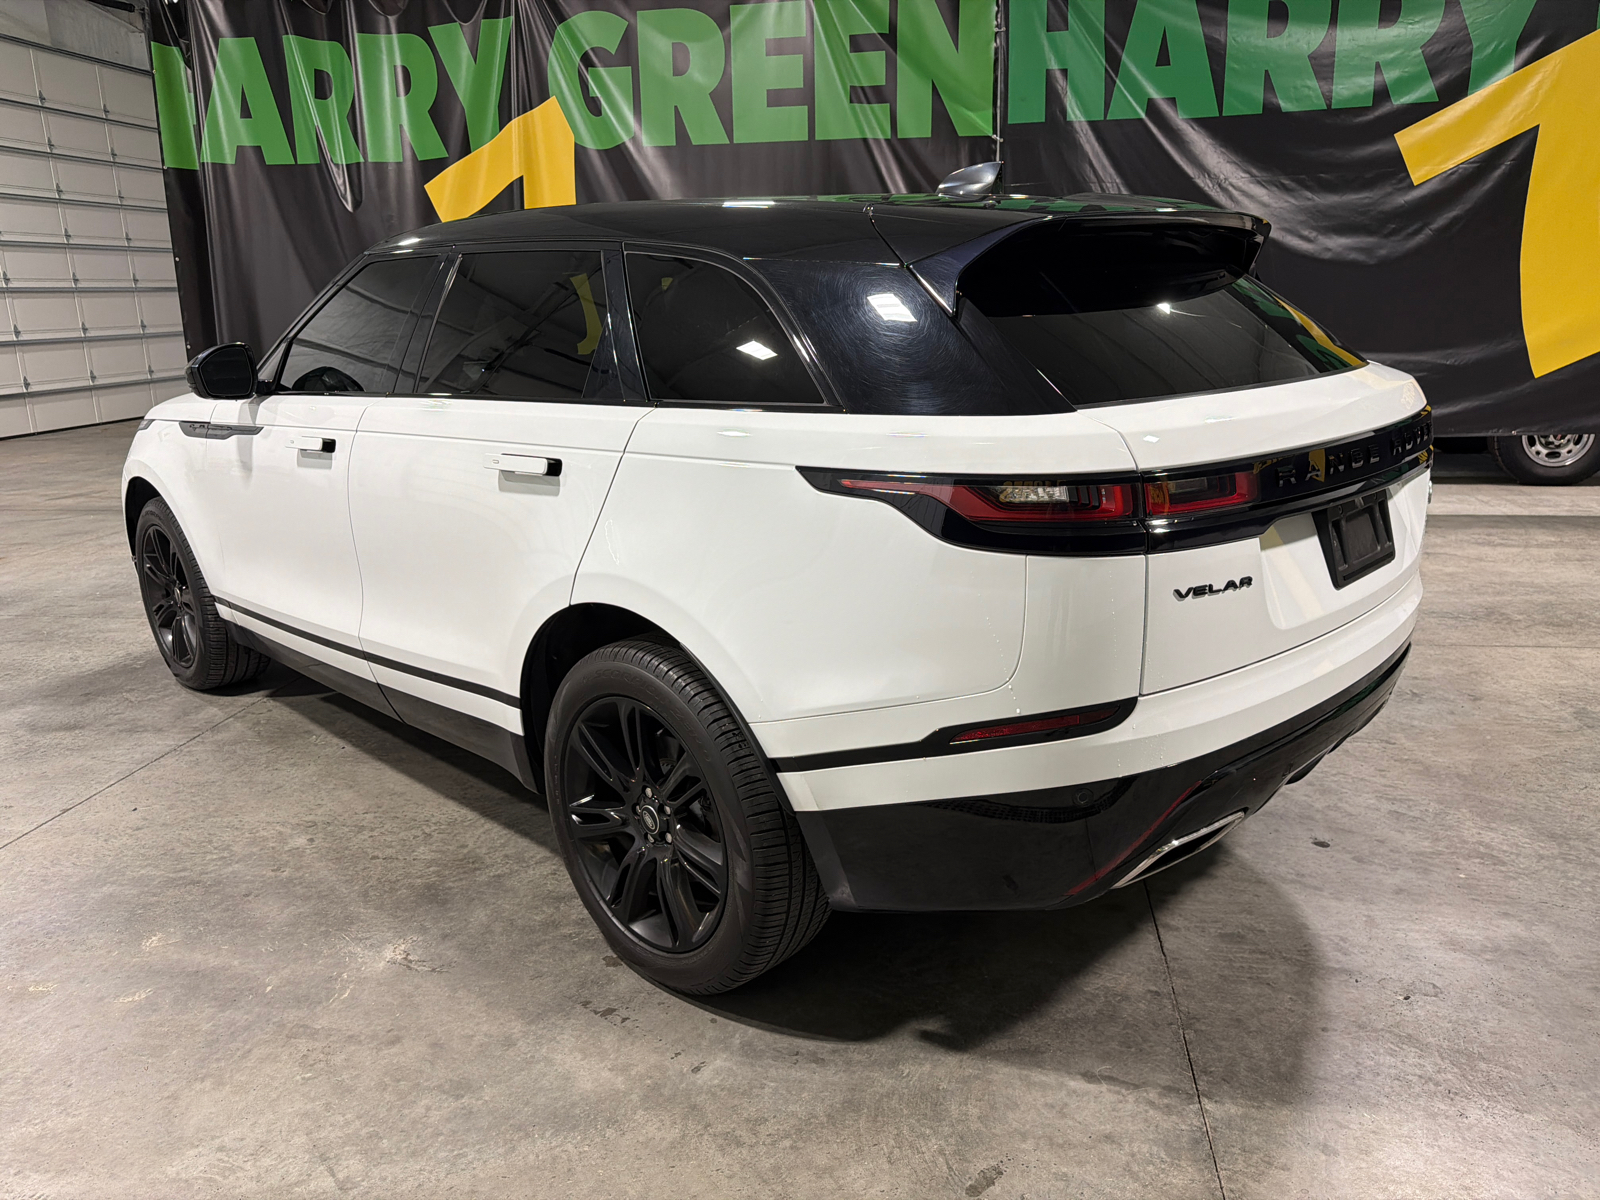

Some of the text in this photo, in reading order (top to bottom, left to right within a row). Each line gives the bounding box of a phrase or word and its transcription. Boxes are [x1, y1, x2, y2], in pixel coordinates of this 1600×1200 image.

[548, 0, 994, 149] GREEN
[1007, 0, 1538, 124] HARRY
[1275, 444, 1381, 488] RANGE
[1173, 575, 1253, 601] VELAR
